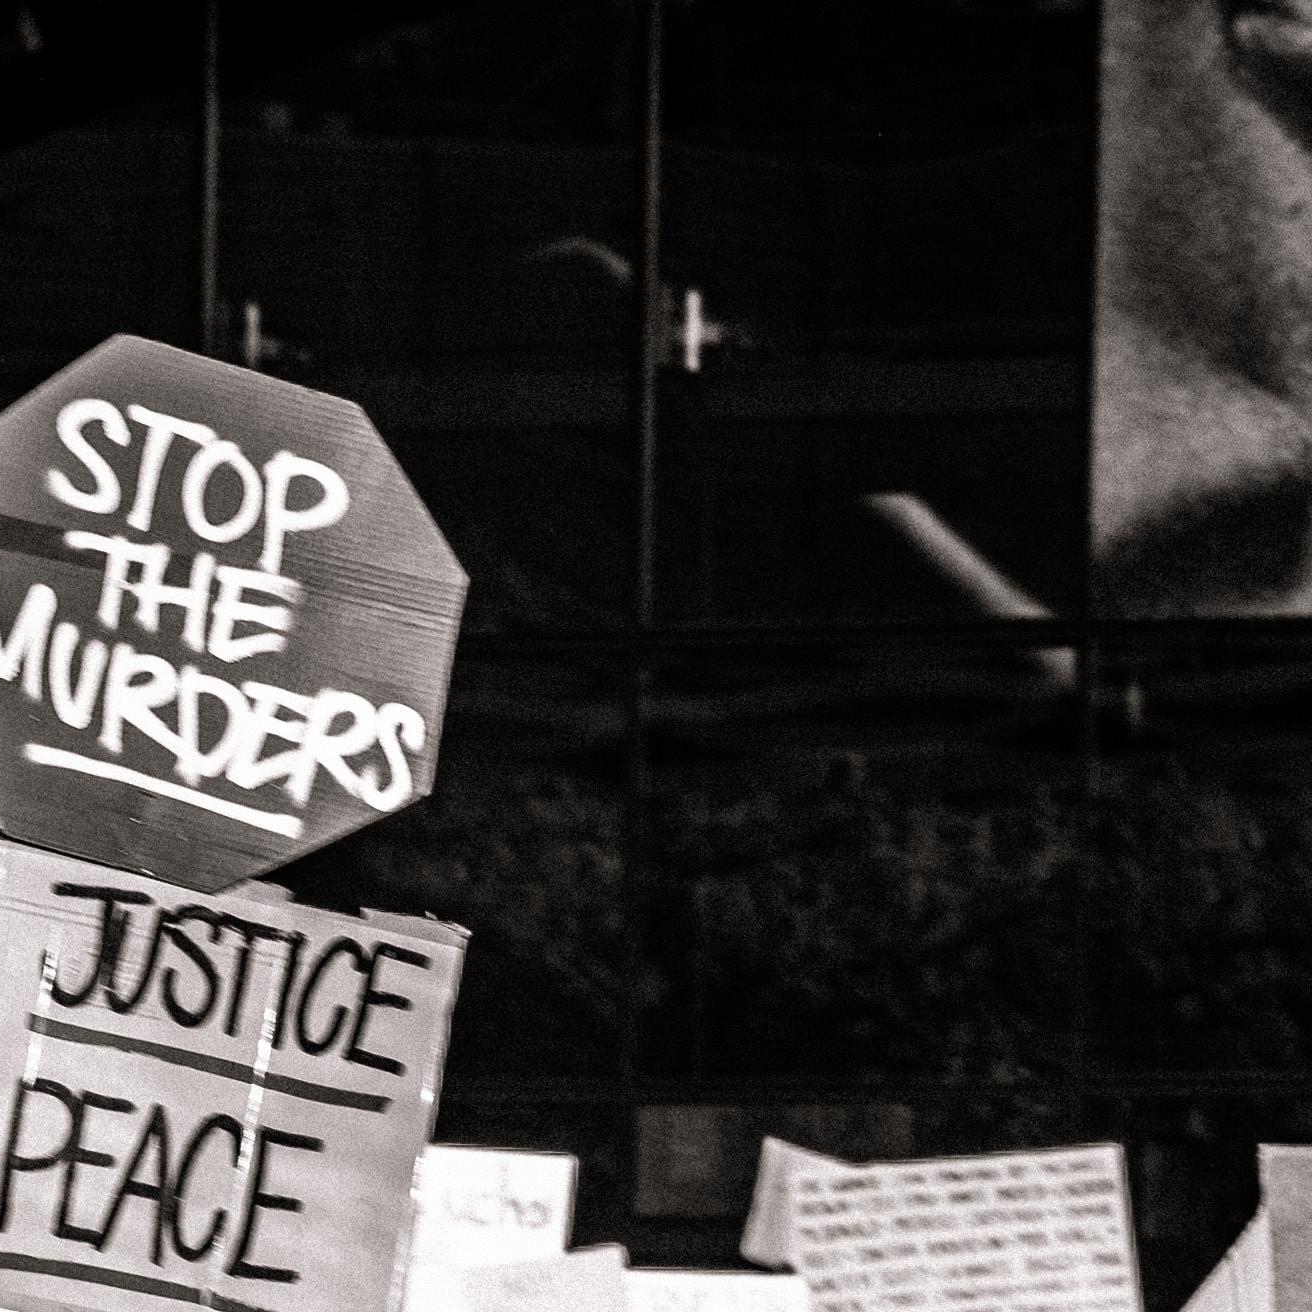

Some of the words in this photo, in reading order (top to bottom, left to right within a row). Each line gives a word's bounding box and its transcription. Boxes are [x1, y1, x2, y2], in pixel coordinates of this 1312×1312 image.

[46, 398, 350, 576] STOP
[63, 530, 304, 664] THE
[43, 882, 429, 1076] JUSTICE
